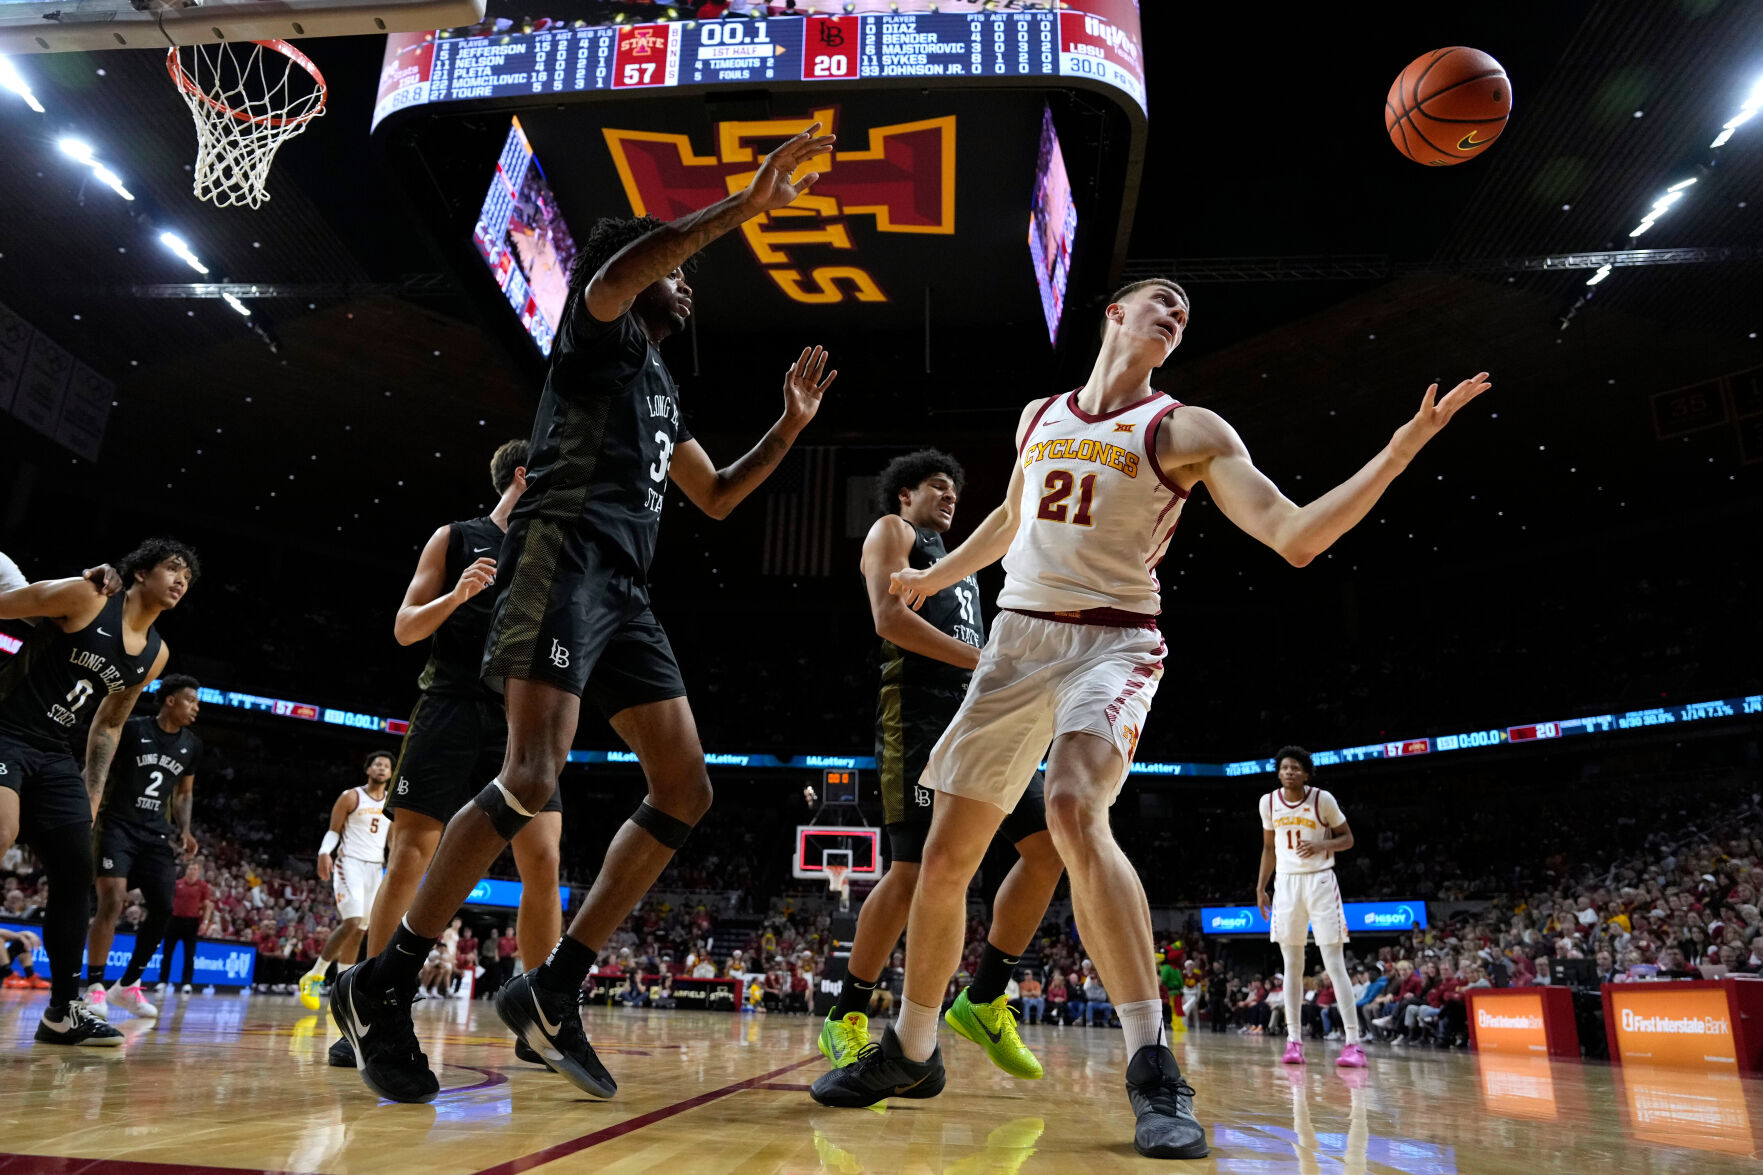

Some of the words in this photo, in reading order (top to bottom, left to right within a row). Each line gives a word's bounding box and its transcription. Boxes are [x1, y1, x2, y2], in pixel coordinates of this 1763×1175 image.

[866, 24, 876, 34] 0
[883, 23, 917, 34] DIAZ
[971, 22, 981, 32] 0
[994, 22, 1004, 31] 0
[1017, 22, 1028, 31] 0
[1040, 21, 1051, 31] 0
[883, 15, 916, 24] PLAYER
[967, 13, 985, 21] PTS
[990, 13, 1007, 21] AST
[1014, 13, 1032, 21] REB
[1037, 13, 1054, 21] FLS
[556, 31, 573, 40] AST
[577, 30, 594, 39] REB
[597, 29, 613, 37] FLS
[621, 36, 665, 51] STATE
[701, 22, 770, 45] 00.1
[866, 34, 876, 45] 2
[882, 33, 938, 45] BENDER
[971, 32, 981, 42] 4
[994, 31, 1005, 42] 0
[1018, 31, 1028, 42] 0
[1041, 31, 1051, 41] 0
[435, 60, 449, 70] 11
[455, 55, 505, 68] NELSON
[535, 52, 546, 62] 0
[556, 50, 567, 60] 0
[578, 48, 589, 59] 0
[598, 47, 609, 57] 0
[440, 50, 449, 60] 5
[456, 43, 526, 59] JEFFERSON
[534, 41, 551, 52] 15
[557, 40, 568, 50] 2
[579, 38, 589, 49] 4
[599, 37, 610, 47] 0
[711, 48, 730, 57] 1ST
[732, 46, 758, 56] HALF
[865, 45, 876, 55] 6
[882, 43, 966, 55] MAJSTOROVIC
[971, 42, 981, 53] 3
[994, 42, 1005, 52] 0
[1018, 42, 1029, 52] 3
[1041, 42, 1052, 52] 2
[1069, 42, 1104, 59] LBSU
[433, 69, 449, 80] 21
[453, 66, 492, 79] PLETA
[534, 62, 545, 72] 4
[555, 60, 566, 70] 0
[576, 58, 587, 69] 2
[598, 57, 606, 67] 1
[708, 58, 761, 70] TIMEOUTS
[766, 57, 775, 67] 2
[814, 55, 848, 76] 20
[861, 55, 878, 66] 11
[882, 54, 928, 65] SYKES
[971, 53, 982, 63] 8
[995, 53, 1004, 63] 1
[1018, 52, 1029, 62] 2
[1041, 52, 1052, 62] 0
[1070, 57, 1105, 77] 30.0
[431, 79, 448, 90] 22
[452, 73, 528, 89] MOMCILOVIC
[530, 71, 548, 82] 16
[554, 70, 565, 80] 0
[576, 68, 586, 79] 2
[595, 67, 607, 77] 0
[624, 63, 656, 84] 57
[694, 71, 702, 81] 5
[719, 69, 750, 80] FOULS
[861, 66, 879, 76] 33
[882, 64, 944, 76] JOHNSON
[946, 64, 966, 75] JR.
[971, 63, 982, 74] 0
[994, 63, 1005, 73] 0
[1019, 63, 1029, 73] 0
[1042, 63, 1052, 73] 2
[430, 89, 447, 100] 27
[451, 85, 493, 99] TOURE
[532, 81, 542, 92] 5
[553, 80, 563, 91] 5
[574, 79, 585, 89] 3
[596, 77, 604, 88] 1
[646, 394, 671, 418] LONG
[650, 430, 674, 484] 3
[1023, 438, 1140, 479] CYCLONES
[644, 487, 664, 513] STA
[1037, 469, 1099, 527] 21
[954, 586, 975, 625] 11
[953, 624, 980, 649] STATE
[549, 637, 570, 668] LB
[69, 647, 106, 672] LONG
[99, 664, 126, 695] BEAC
[275, 700, 294, 716] 57
[1707, 703, 1734, 716] 7.1%
[344, 712, 380, 731] 0:00.1
[1535, 722, 1556, 739] 20
[1458, 729, 1500, 748] 0:00.0
[1387, 741, 1404, 757] 57
[136, 753, 158, 768] LONG
[158, 754, 185, 776] BEACH
[144, 770, 164, 797] 2
[396, 775, 410, 795] LB
[135, 796, 162, 811] STATE
[914, 785, 931, 807] LB
[369, 817, 380, 834] 5
[1272, 816, 1317, 831] CYCLONES
[1656, 1015, 1705, 1034] Interstate
[1704, 1016, 1729, 1035] Bank
